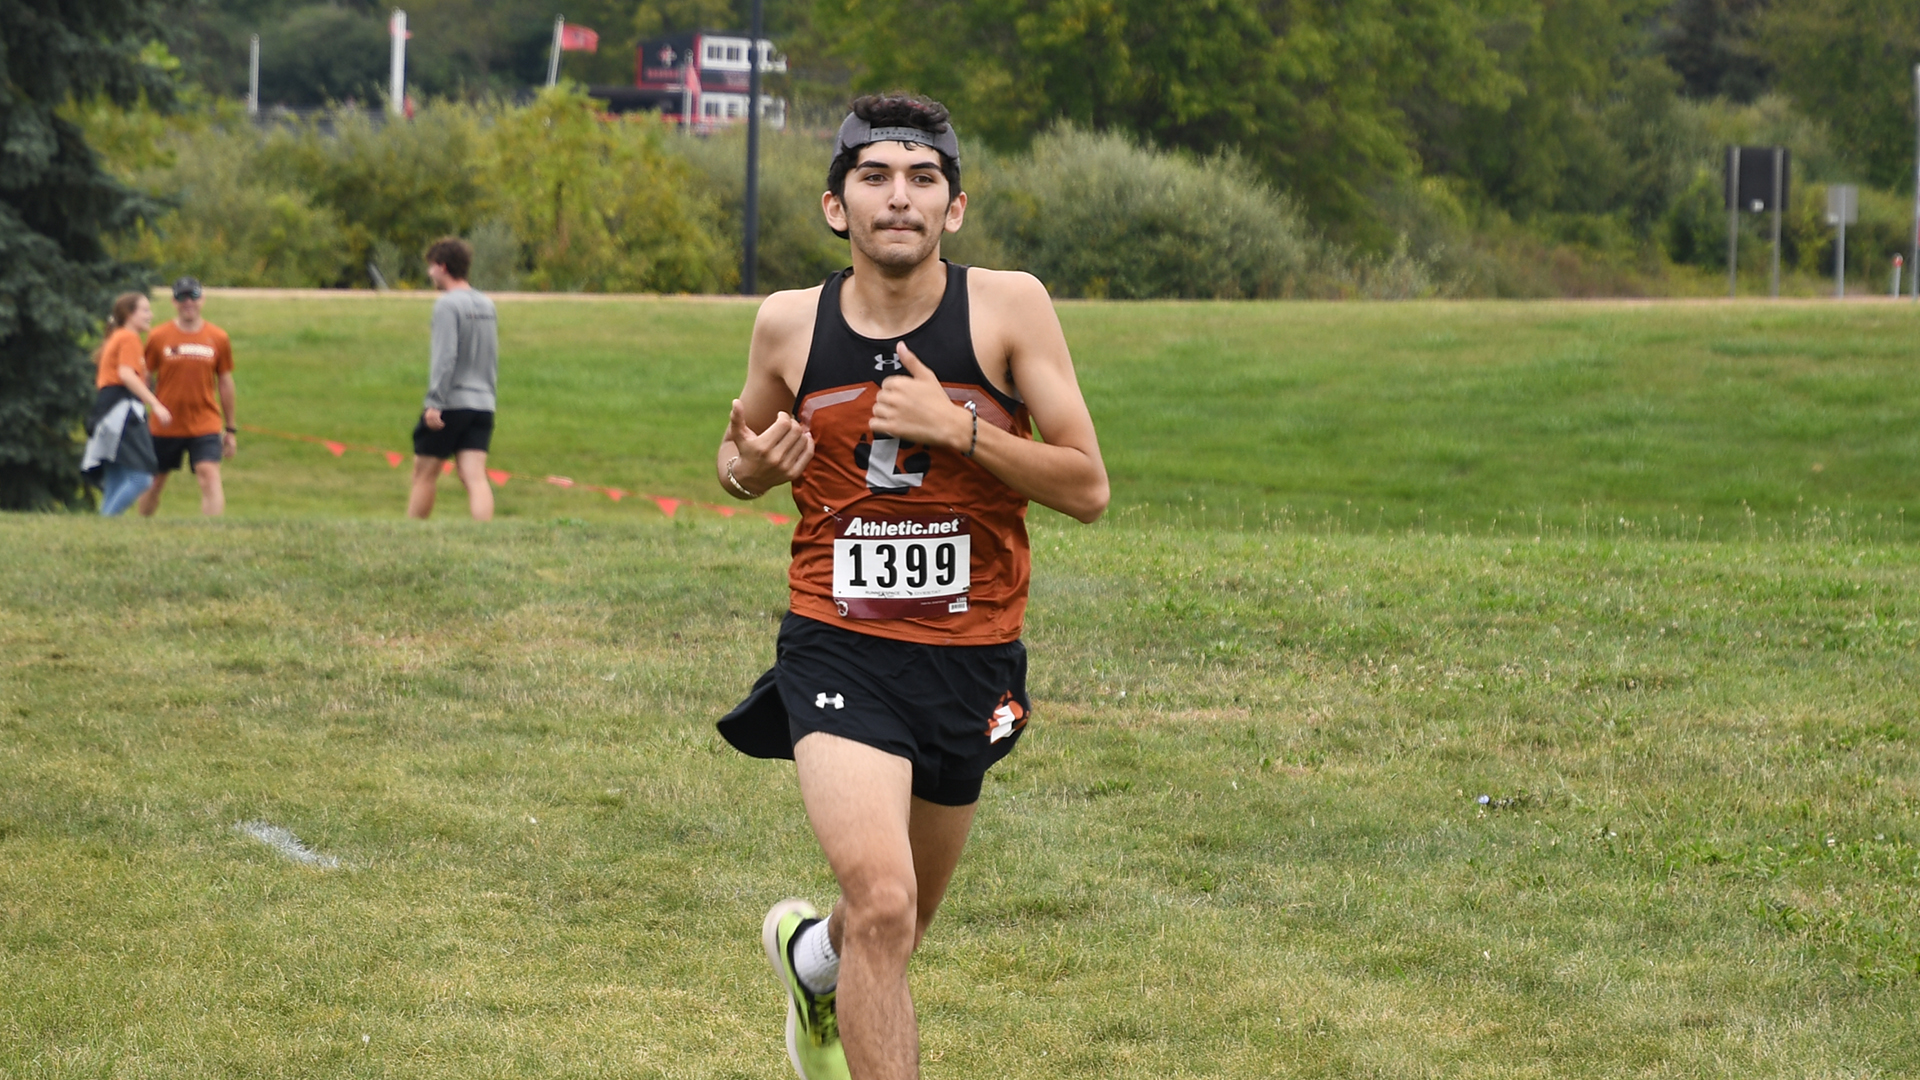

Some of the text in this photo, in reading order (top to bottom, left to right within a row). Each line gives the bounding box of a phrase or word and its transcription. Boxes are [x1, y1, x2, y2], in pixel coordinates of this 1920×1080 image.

[866, 439, 924, 488] L
[844, 517, 960, 536] Athletic.net
[849, 543, 956, 588] 1399
